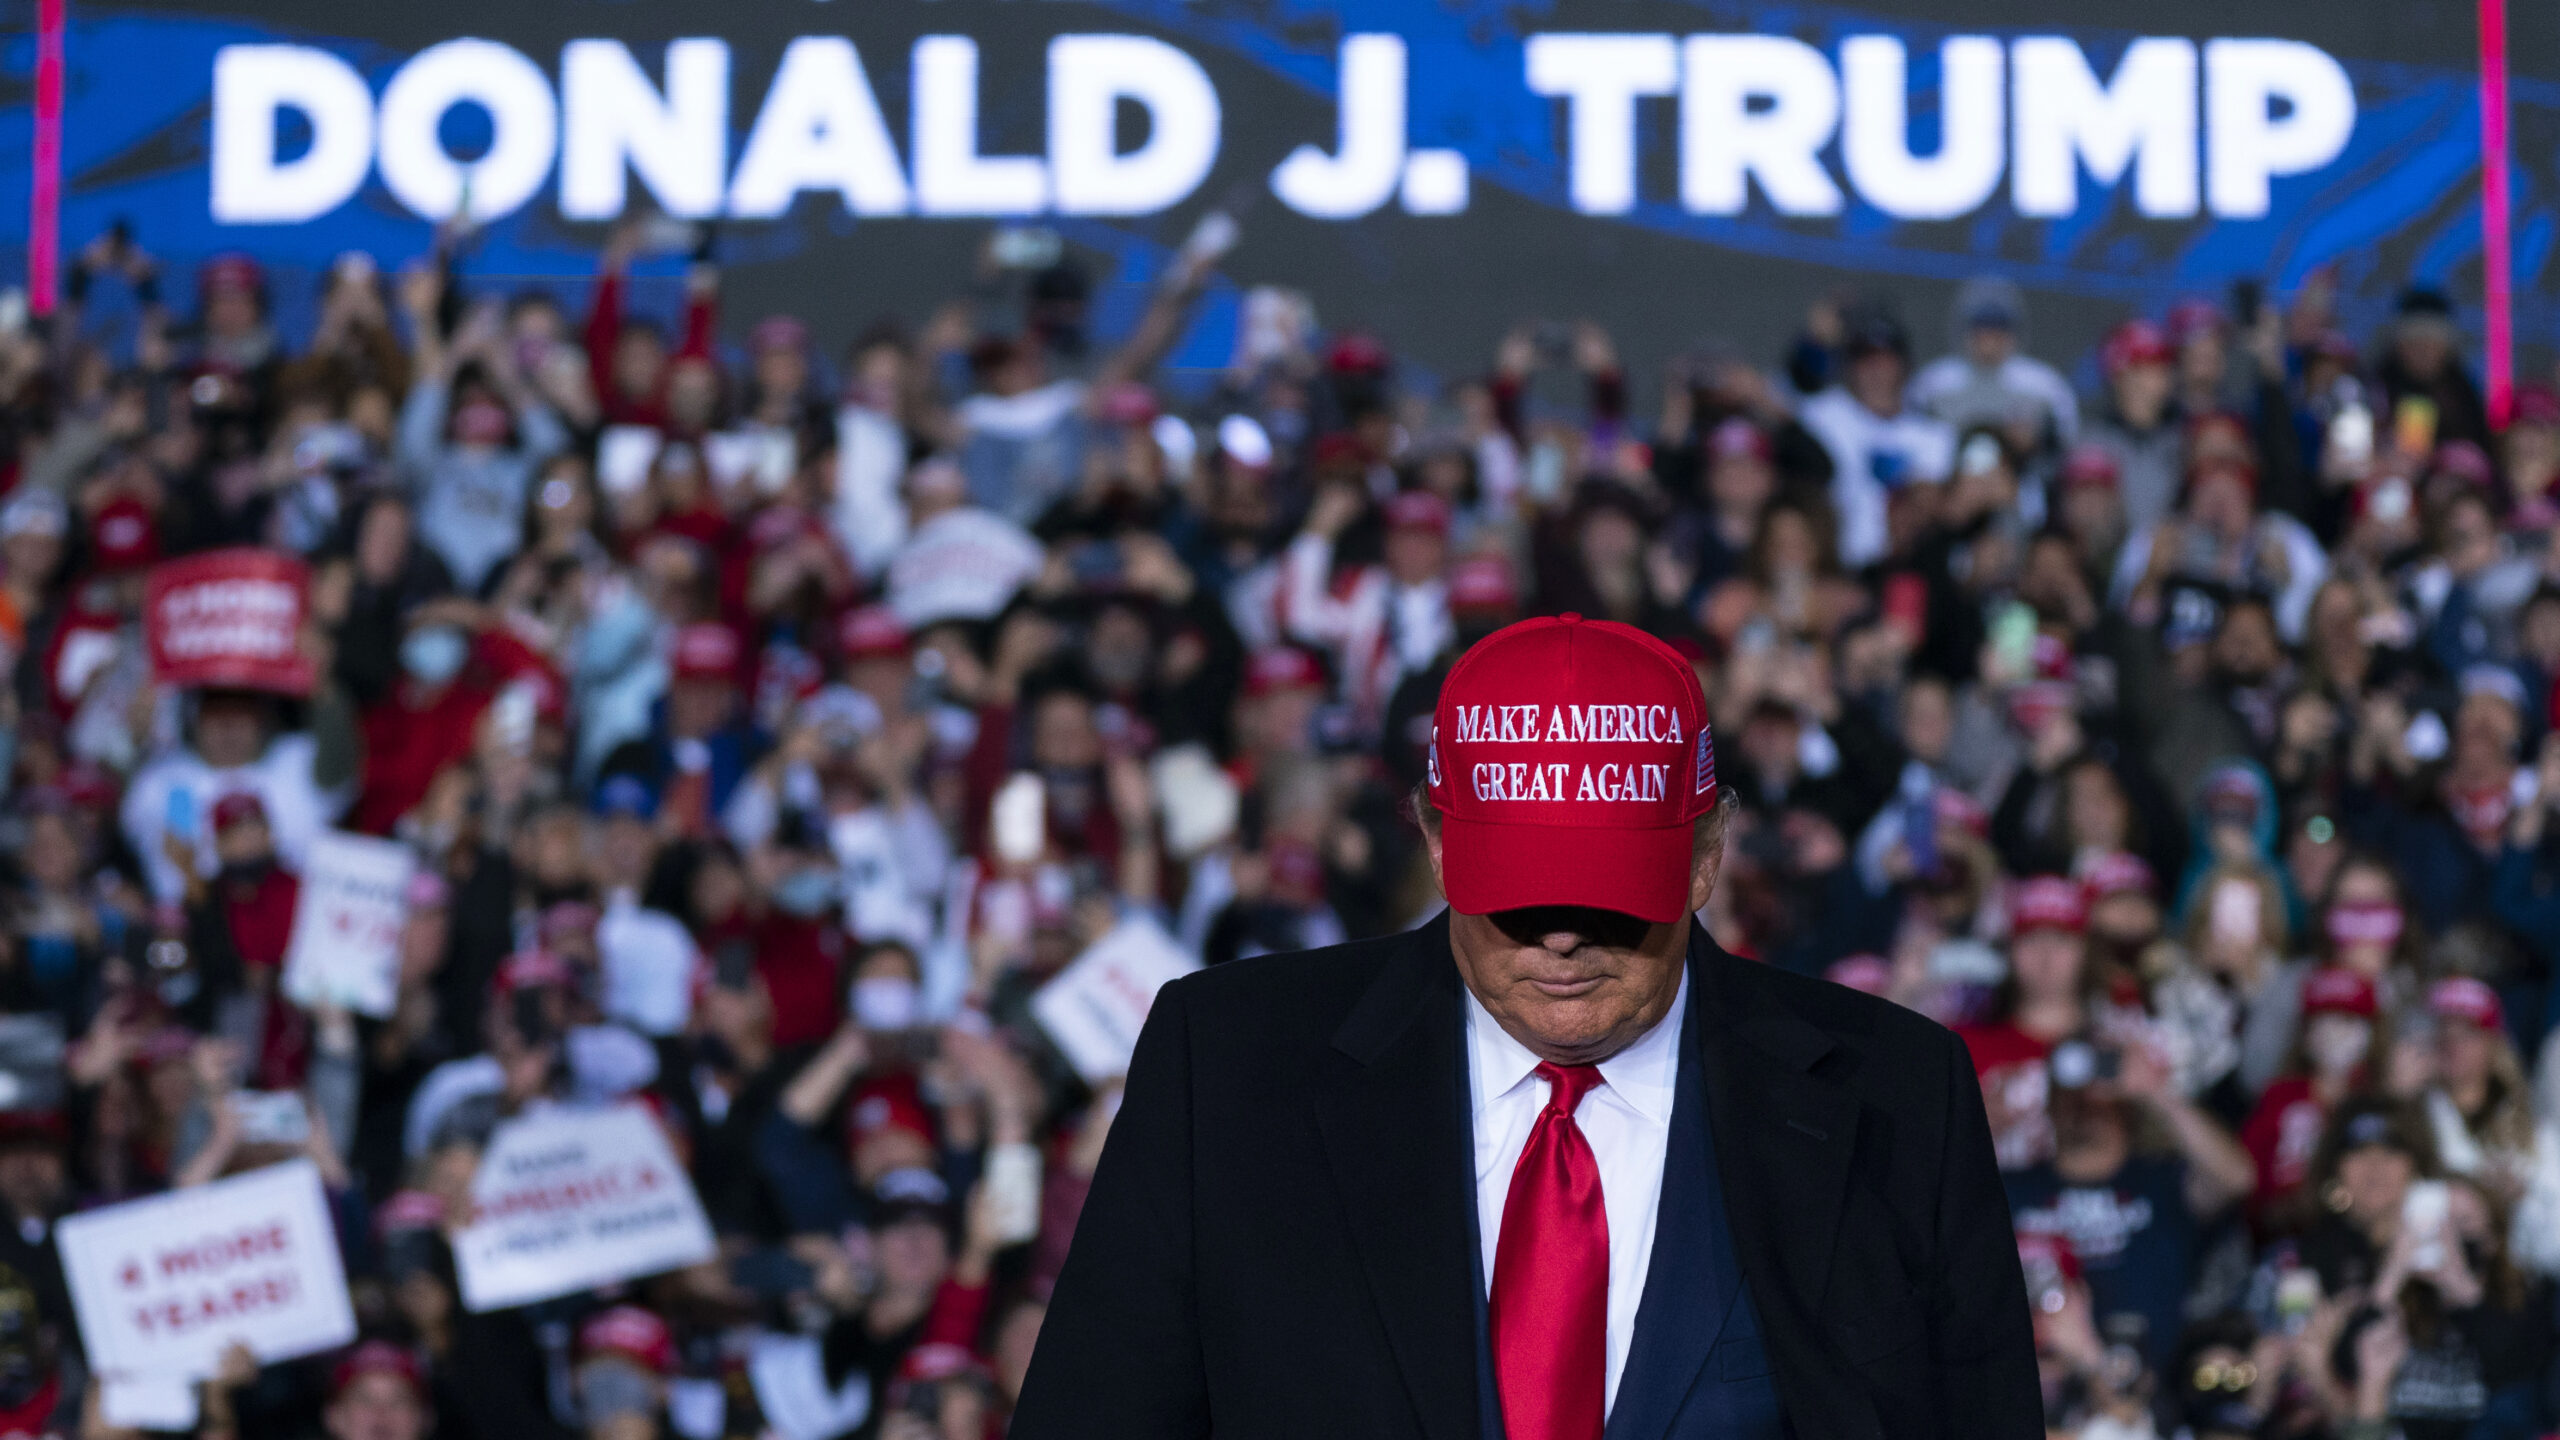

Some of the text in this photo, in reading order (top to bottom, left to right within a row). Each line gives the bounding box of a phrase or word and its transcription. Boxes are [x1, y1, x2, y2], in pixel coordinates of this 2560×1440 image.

[211, 34, 2358, 223] DONALD J. TRUMP
[1455, 704, 1684, 744] MAKE AMERICA
[1472, 762, 1671, 803] GREAT AGAIN
[157, 1220, 290, 1277] MORE
